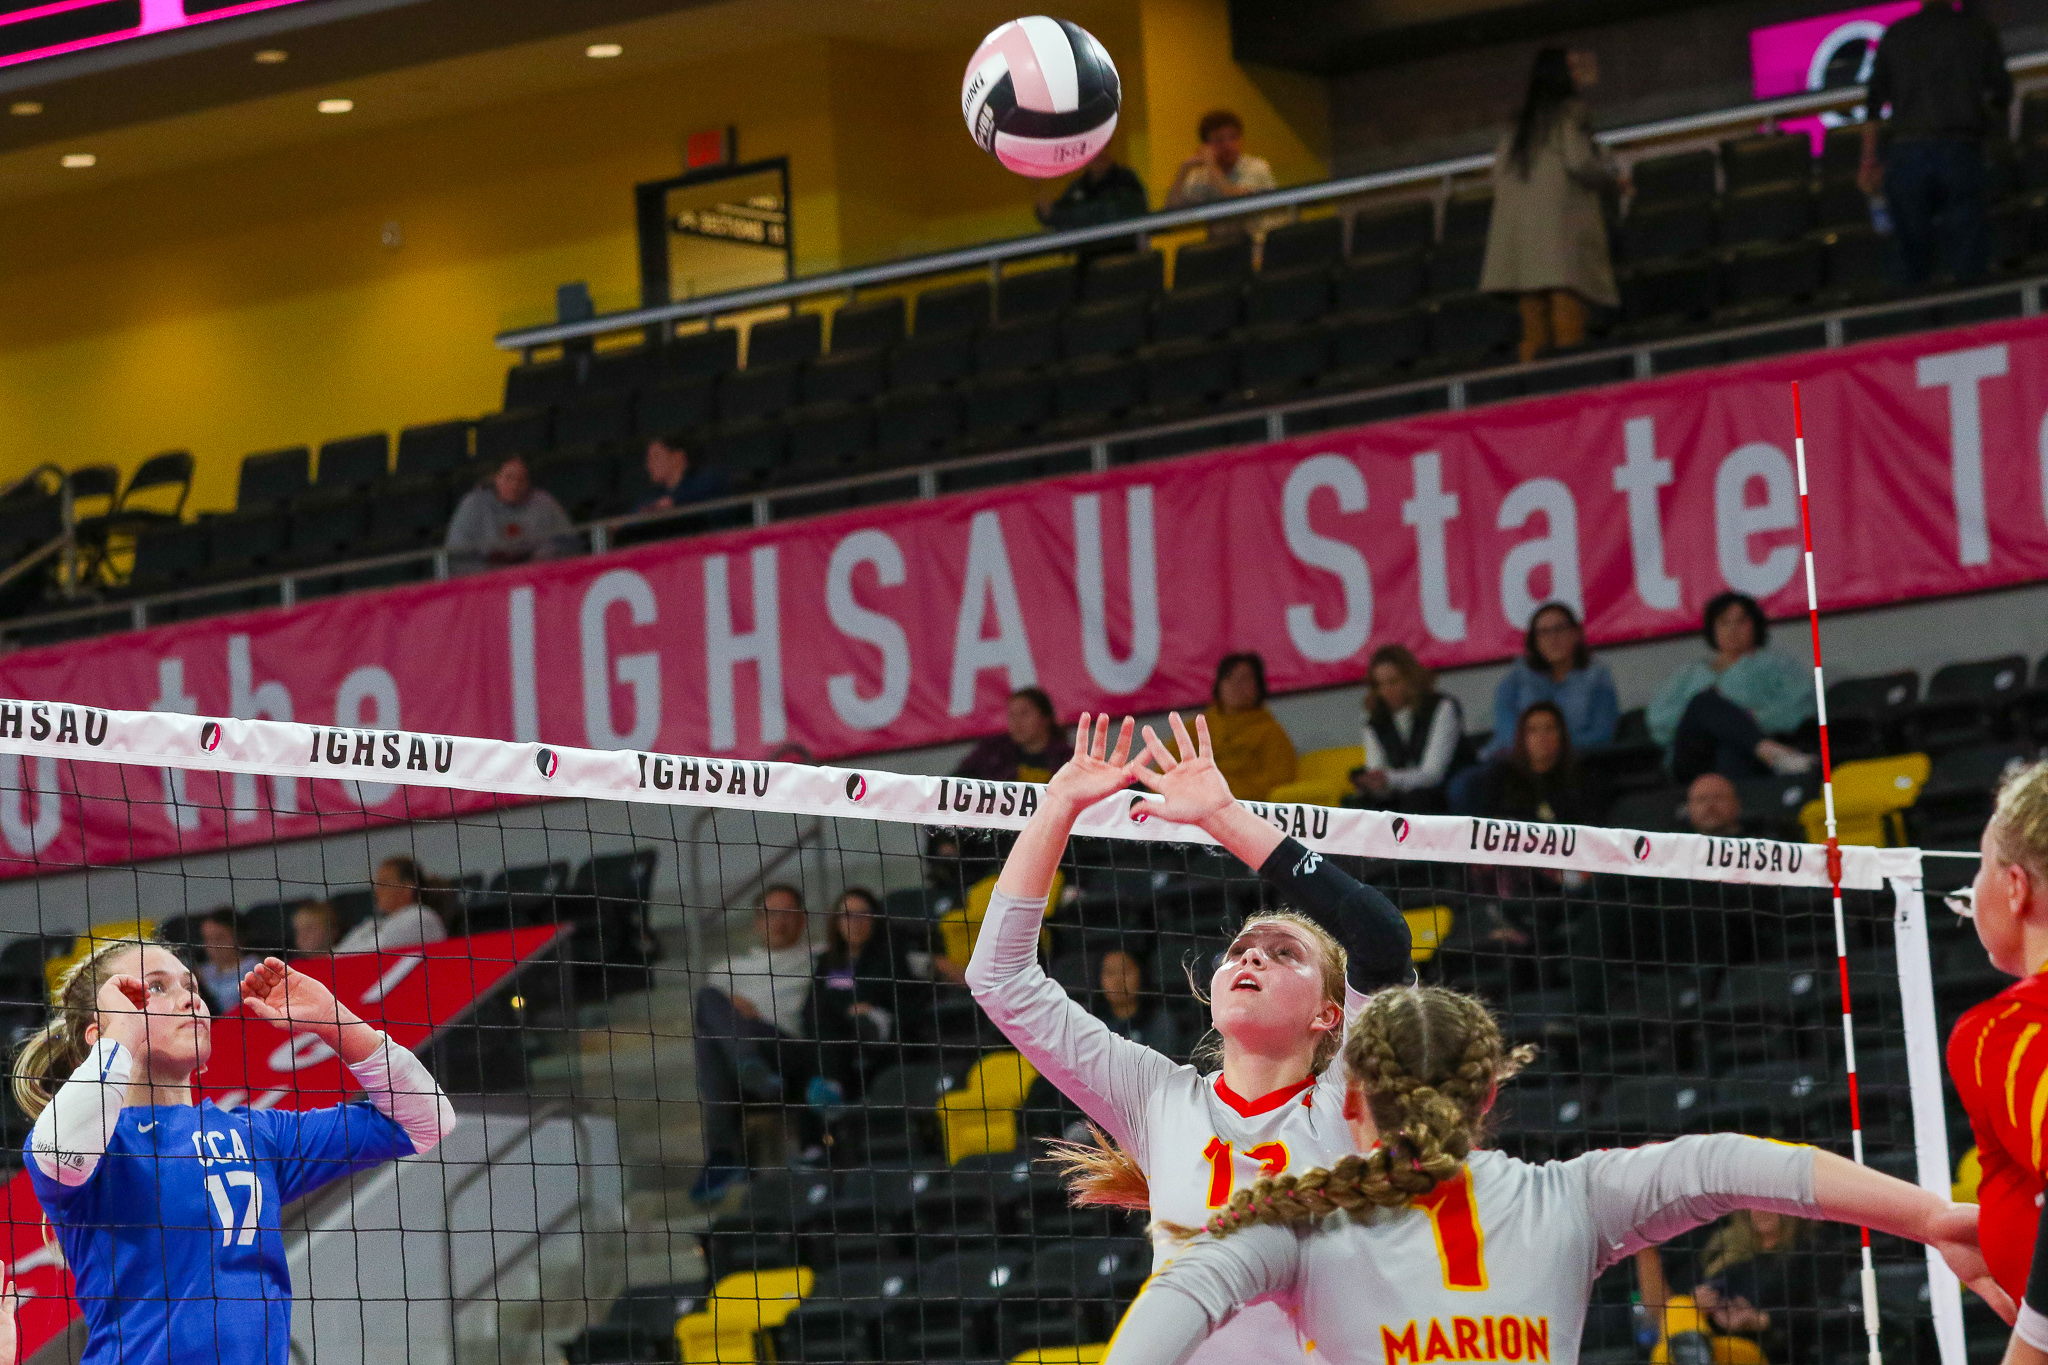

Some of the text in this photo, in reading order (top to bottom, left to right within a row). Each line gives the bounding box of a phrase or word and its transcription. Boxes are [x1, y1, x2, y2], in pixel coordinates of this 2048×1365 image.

[152, 634, 402, 831] the
[507, 484, 1162, 754] IGHSAU
[1281, 414, 1800, 664] State
[1917, 344, 2048, 566] T
[309, 725, 455, 774] IGHSAU
[637, 752, 771, 798] IGHSAU
[938, 778, 1048, 817] IGHSA
[1470, 819, 1578, 857] IGHSAU
[1706, 838, 1803, 874] IGHSAU
[191, 1127, 250, 1167] CCA
[203, 1170, 263, 1248] 17
[1411, 1165, 1490, 1292] 1
[1379, 1314, 1551, 1365] MARION
